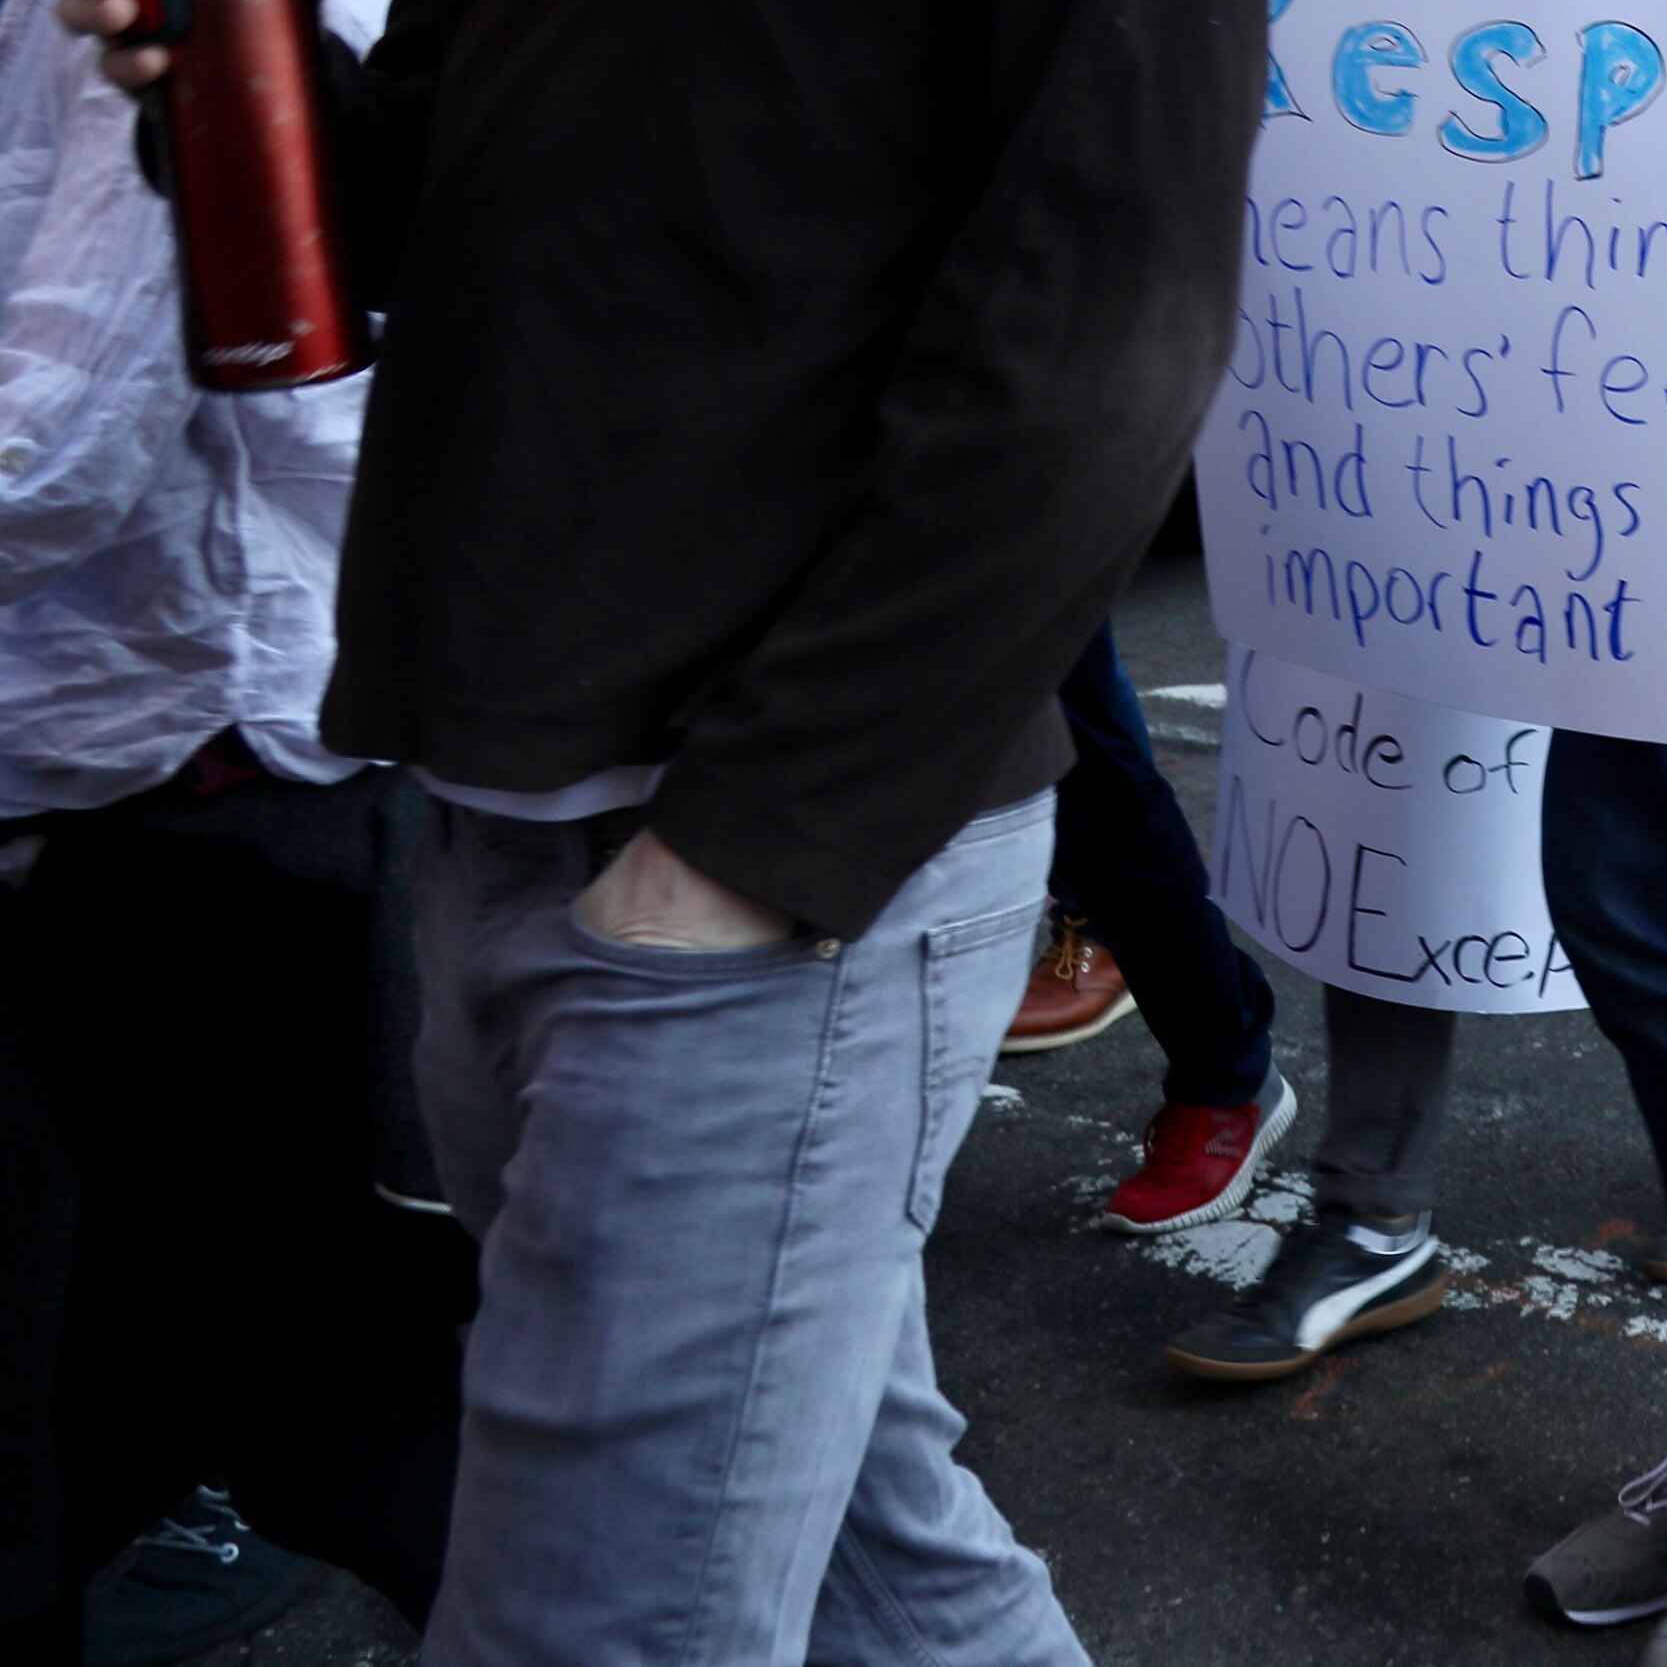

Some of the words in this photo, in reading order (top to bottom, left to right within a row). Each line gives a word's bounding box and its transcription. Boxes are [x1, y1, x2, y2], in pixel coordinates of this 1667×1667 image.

[1246, 409, 1374, 519] and
[1406, 434, 1642, 582] things
[1262, 525, 1643, 665] important
[1240, 649, 1412, 790] Code
[1442, 728, 1536, 795] of
